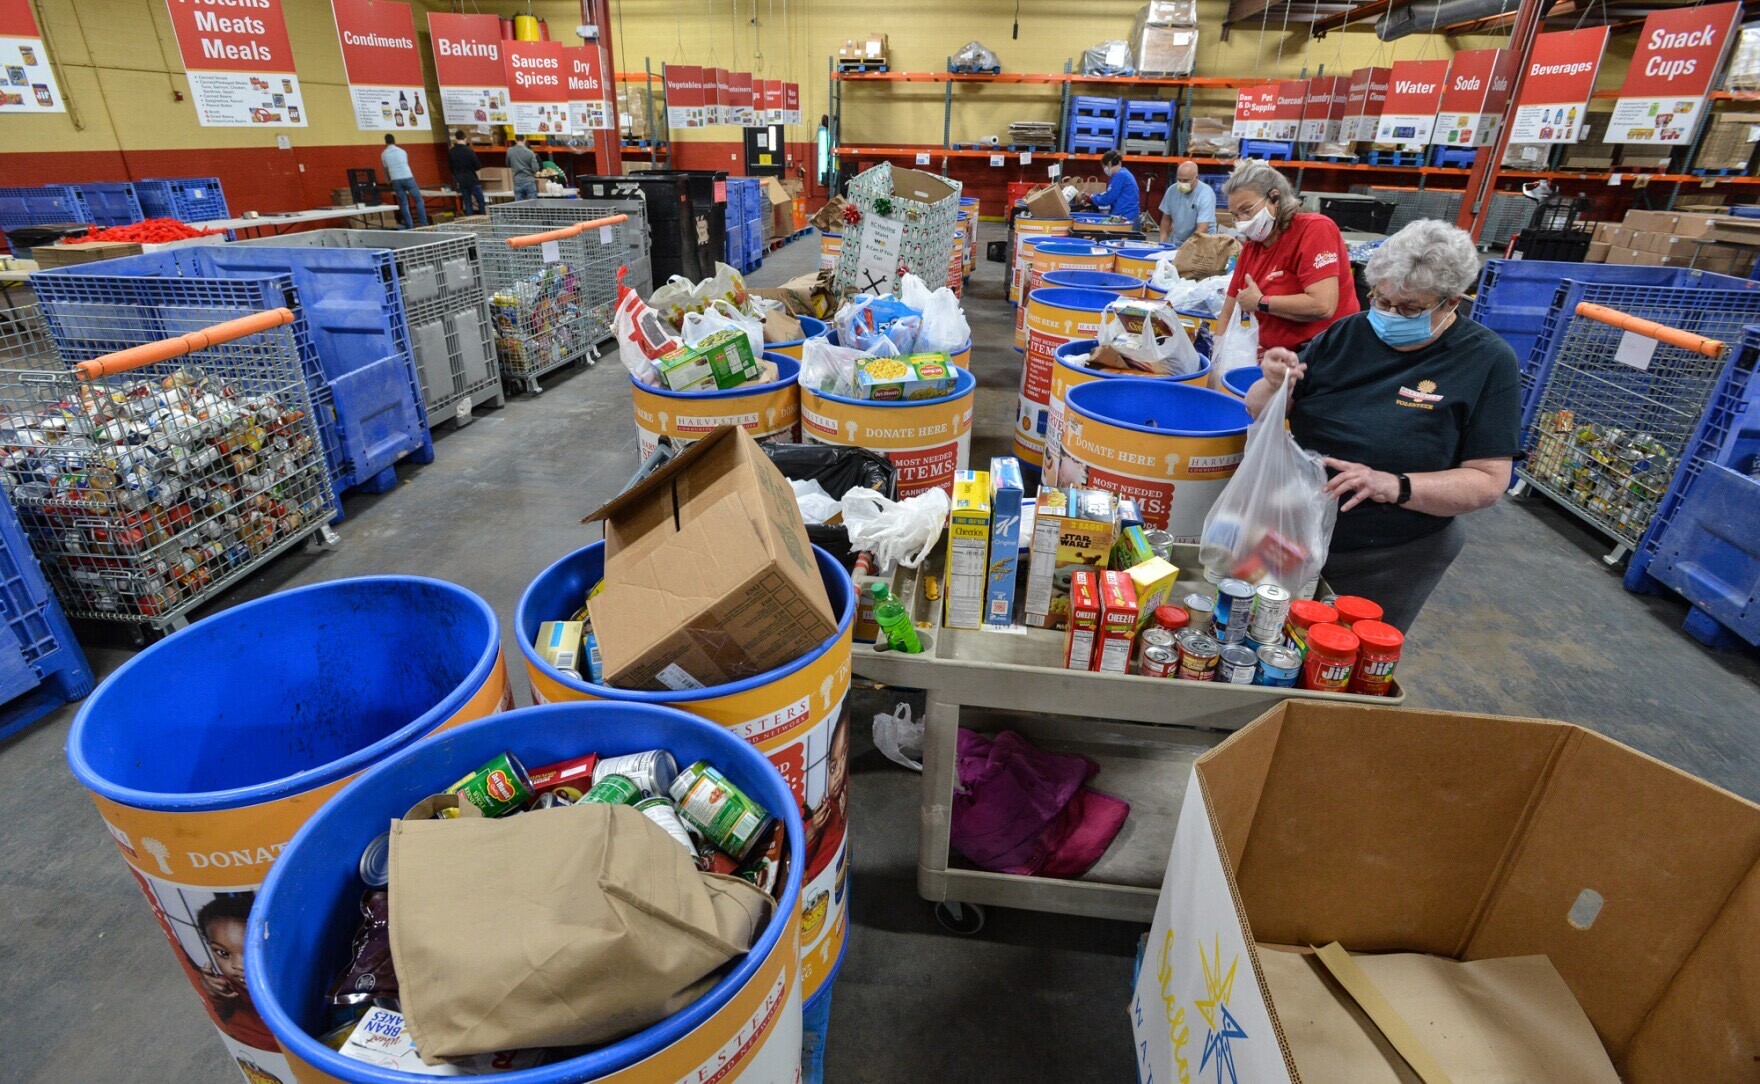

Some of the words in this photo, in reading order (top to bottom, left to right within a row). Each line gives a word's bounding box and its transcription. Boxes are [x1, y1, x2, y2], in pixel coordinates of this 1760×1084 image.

[194, 10, 266, 35] Meats
[343, 30, 414, 49] Condiments
[1647, 24, 1717, 51] Snack
[201, 38, 272, 61] Meals
[438, 37, 499, 61] Baking
[511, 54, 559, 69] Sauces
[573, 59, 591, 76] Dry
[1530, 60, 1593, 77] Beverages
[1644, 55, 1698, 81] Cups
[515, 71, 559, 88] Spices
[568, 76, 599, 90] Meals
[667, 80, 702, 90] Vegetables
[1395, 80, 1437, 94] Water
[1453, 75, 1482, 91] Soda
[1491, 75, 1508, 91] Soda
[1261, 93, 1273, 102] Pet
[1277, 96, 1304, 106] Charcoal
[1307, 93, 1332, 105] Laundry
[1250, 102, 1276, 112] Supplie
[1030, 341, 1055, 356] ITEM
[1042, 340, 1062, 348] NEEDE
[781, 405, 798, 418] DON
[1395, 398, 1435, 411] VOLUNTEER
[677, 413, 758, 427] HARVESTERS
[865, 427, 915, 439] DONATE
[918, 423, 948, 436] HERE
[895, 458, 922, 467] MOST
[923, 451, 954, 464] NEEDED
[1075, 436, 1115, 460] DONATE
[1117, 451, 1157, 468] HERE
[1191, 455, 1243, 467] HARVEST
[896, 459, 956, 482] ITEMS:
[1092, 476, 1119, 490] MOST
[1120, 484, 1164, 499] NEEDED
[955, 526, 984, 537] Cheerios
[995, 515, 1020, 538] K
[1078, 523, 1104, 533] BAGS!
[1143, 521, 1159, 530] ODS
[994, 538, 1017, 547] Original
[1060, 533, 1092, 543] STAR
[1060, 539, 1092, 549] WARS
[1321, 665, 1351, 680] Jif
[1364, 661, 1394, 676] Jif
[730, 700, 807, 736] ESTERS
[760, 715, 808, 742] NETWORK
[491, 772, 500, 785] Del
[498, 781, 511, 800] Monte
[472, 789, 487, 809] WHOLE
[186, 841, 287, 869] DONAT
[371, 1011, 405, 1026] AKES
[363, 1020, 402, 1037] BRAN
[690, 974, 785, 1084] ESTERS
[365, 1034, 402, 1048] Wheat
[703, 1058, 736, 1084] OOD
[740, 994, 785, 1056] NETWORK
